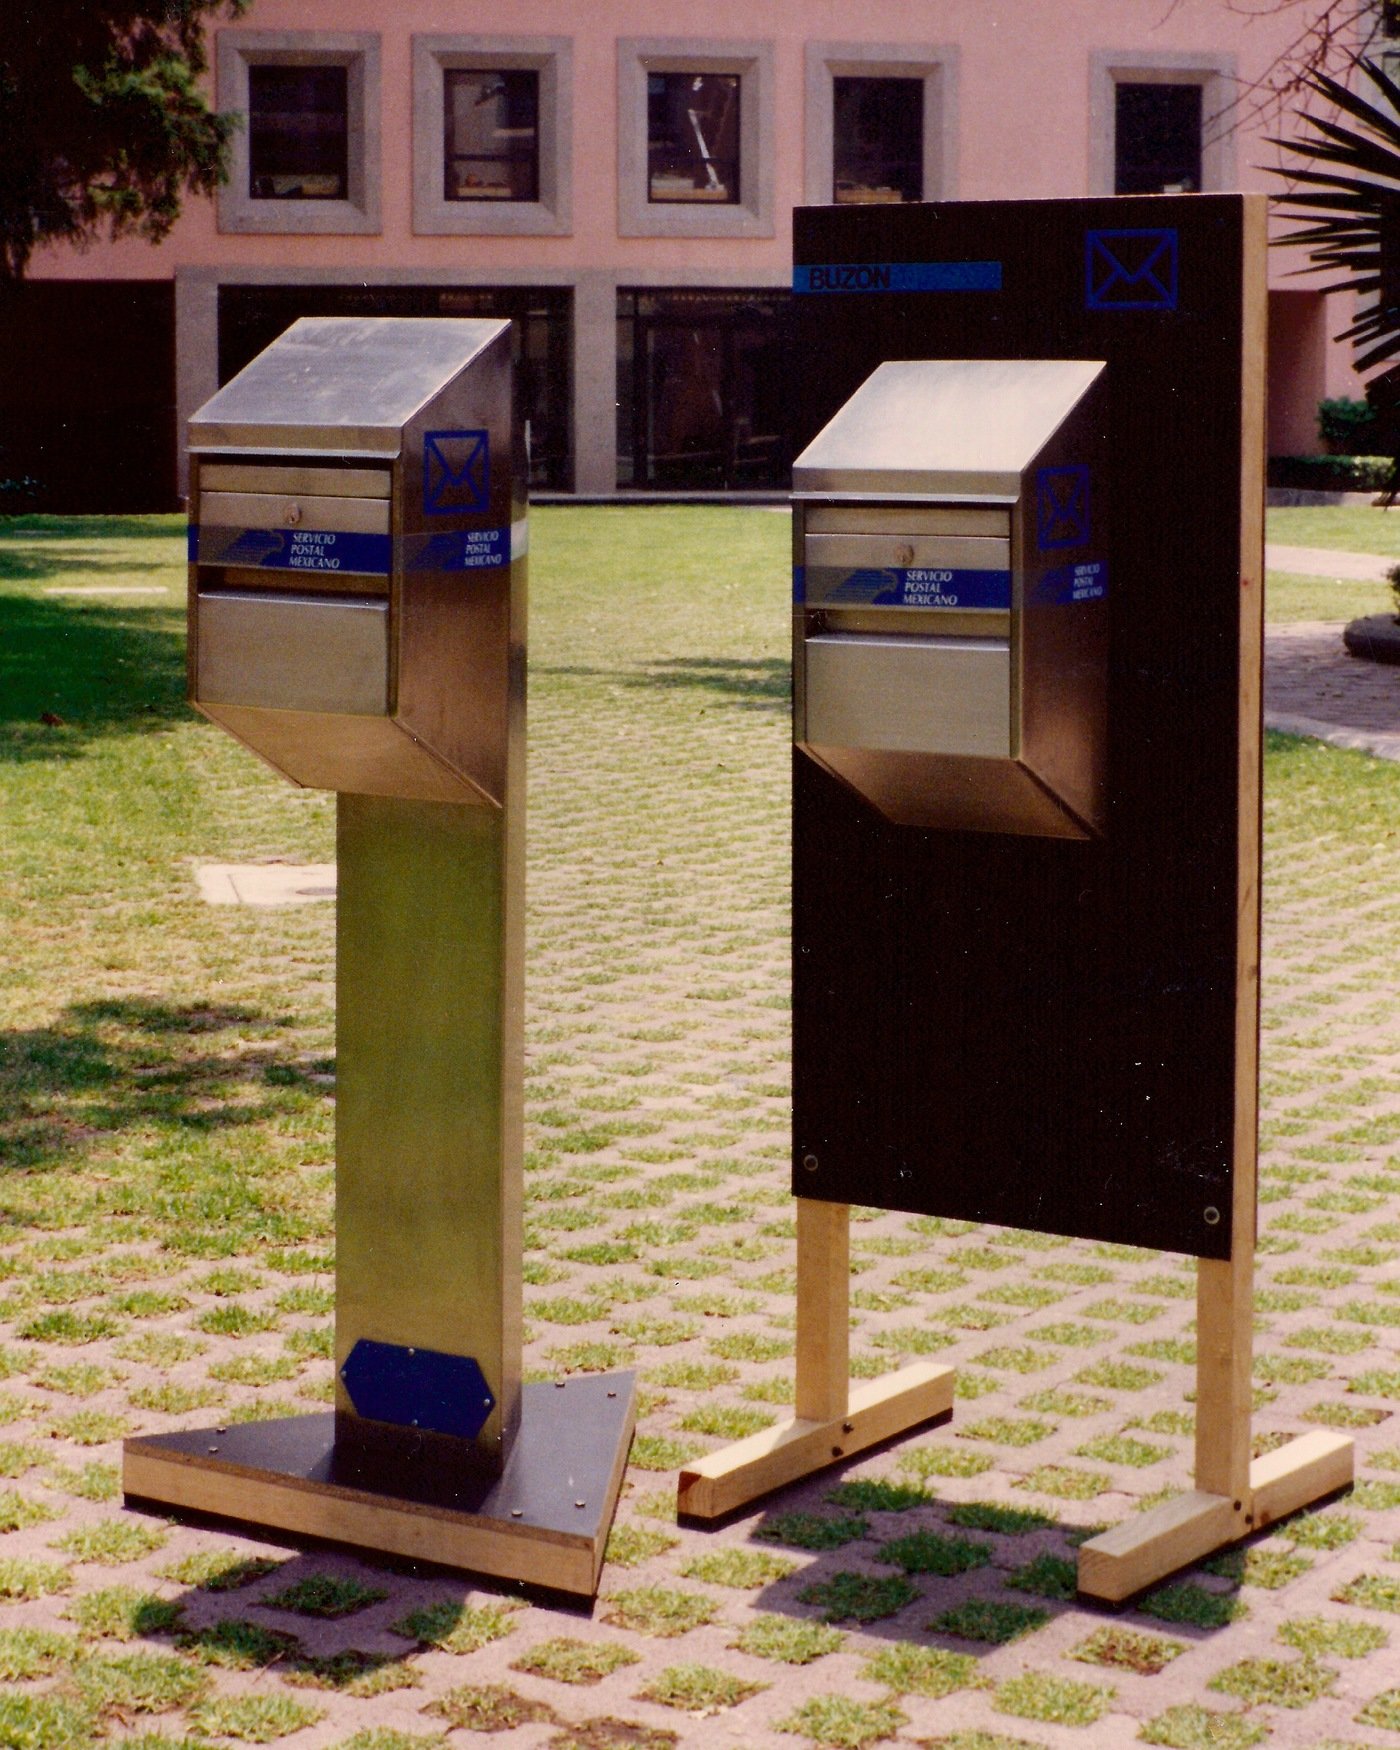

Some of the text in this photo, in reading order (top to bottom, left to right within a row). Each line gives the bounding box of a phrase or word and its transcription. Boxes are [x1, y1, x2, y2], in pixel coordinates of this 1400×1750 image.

[809, 266, 891, 290] BUZON
[293, 532, 336, 545] SERVICIO
[291, 544, 325, 556] POSTAL
[289, 556, 341, 569] MEXICANO
[906, 570, 953, 582] SERVICIO
[905, 581, 941, 593] POSTAL
[903, 594, 958, 606] MEXICANO
